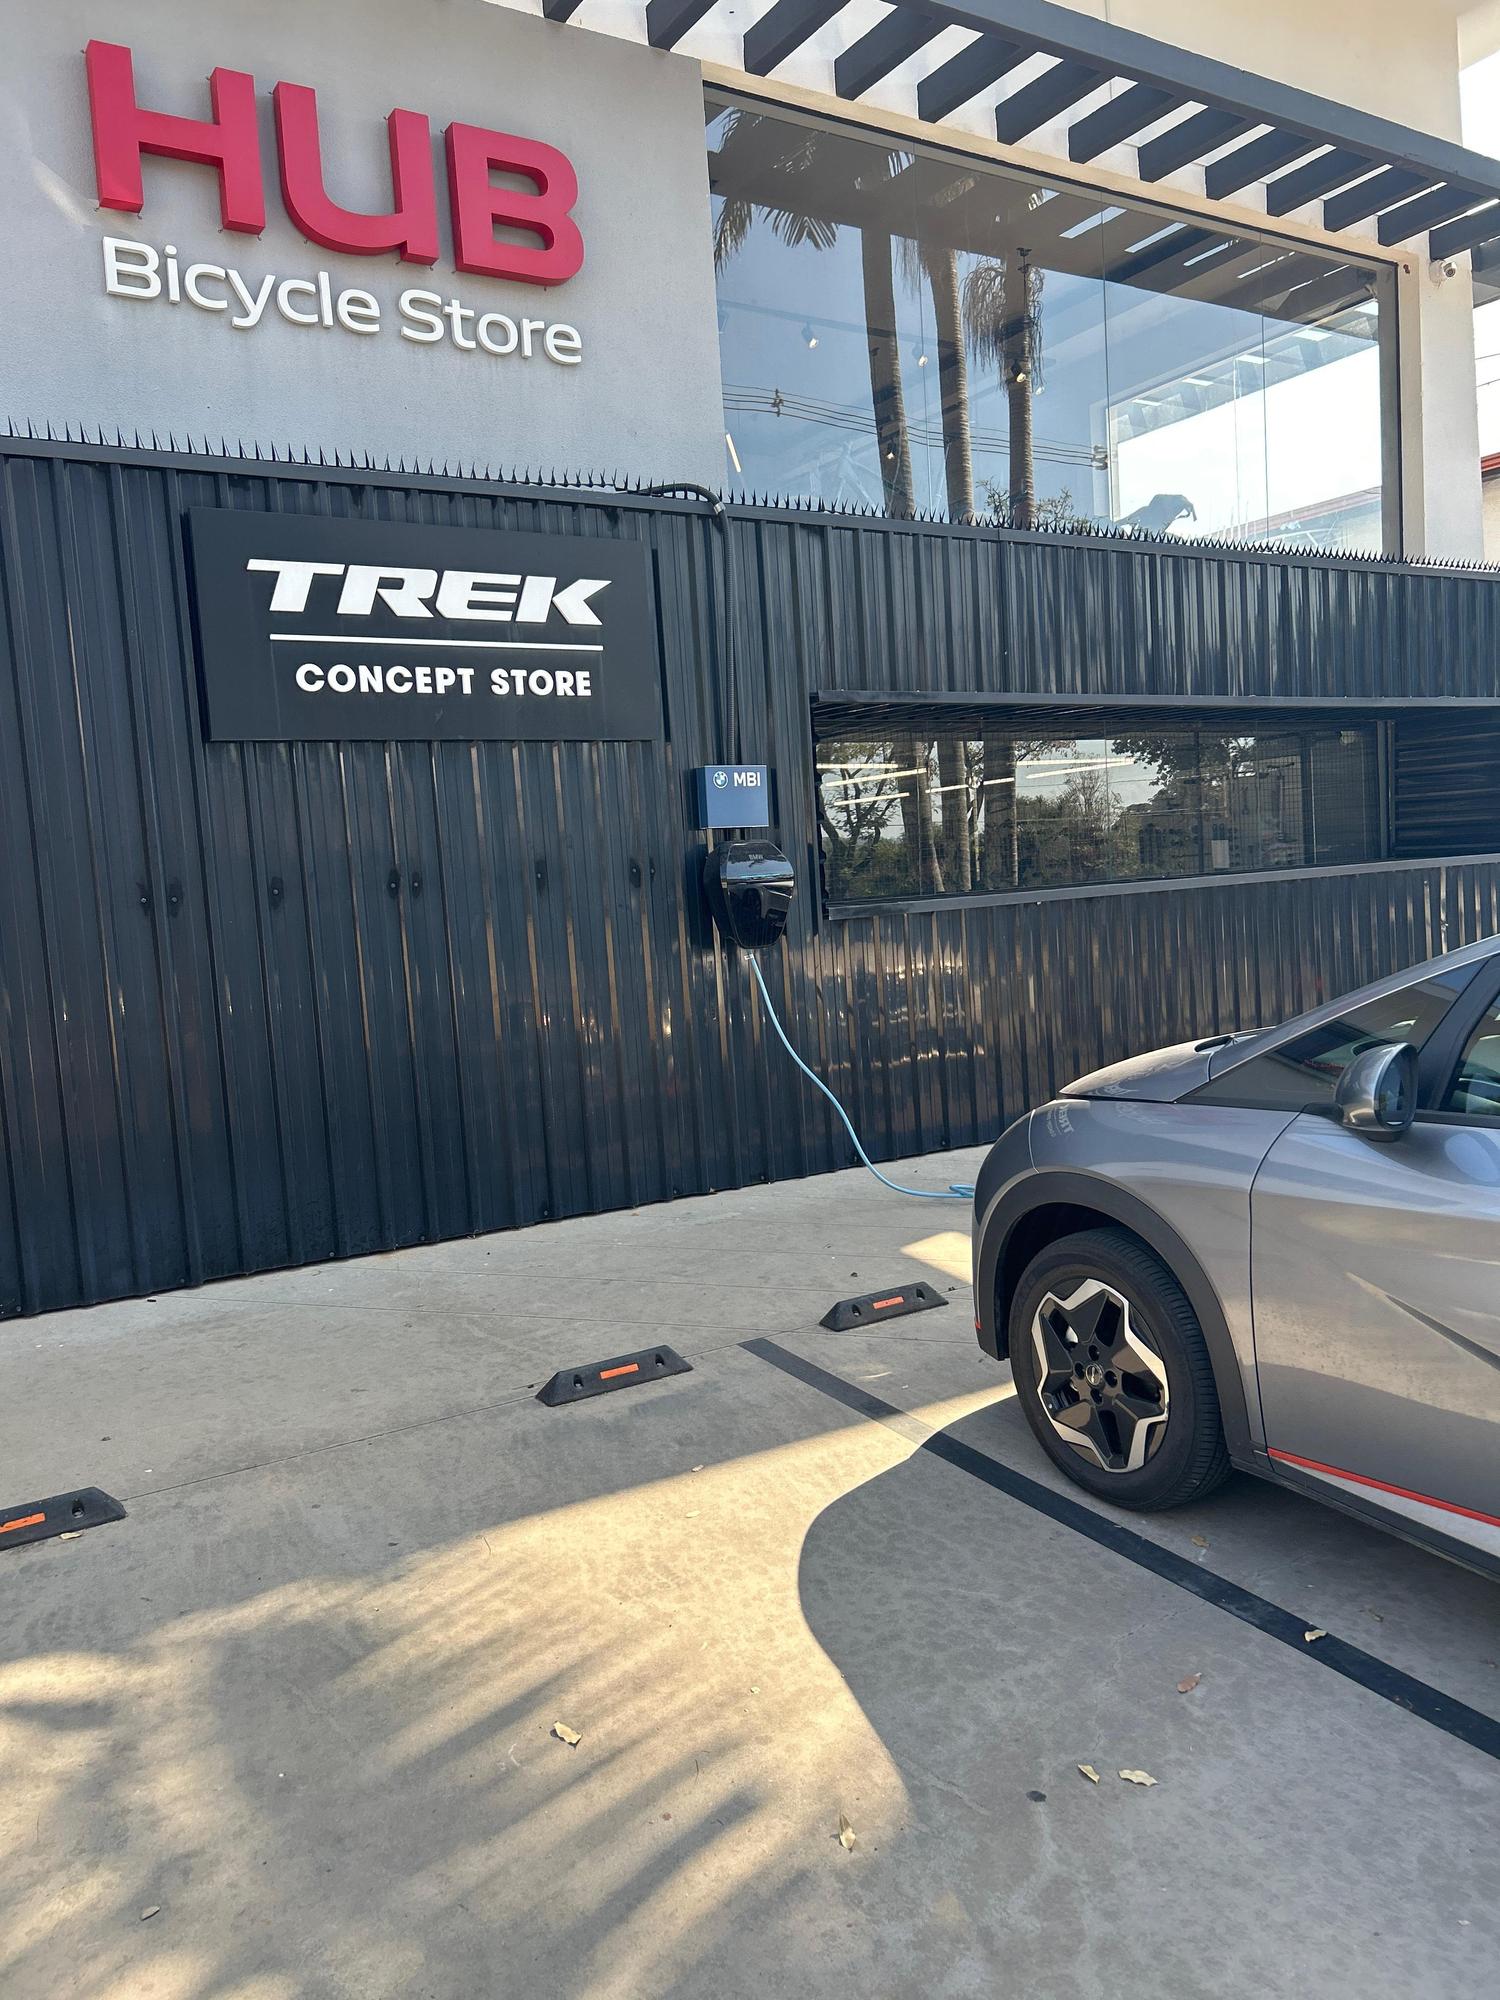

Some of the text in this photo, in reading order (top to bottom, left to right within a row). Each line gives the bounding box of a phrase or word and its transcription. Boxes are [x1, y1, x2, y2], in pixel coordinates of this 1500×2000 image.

[85, 39, 585, 287] HUB
[102, 236, 583, 365] Bicycle Store
[246, 558, 612, 625] TREK
[295, 663, 592, 697] CONCEPT STORE
[733, 771, 761, 787] MBI
